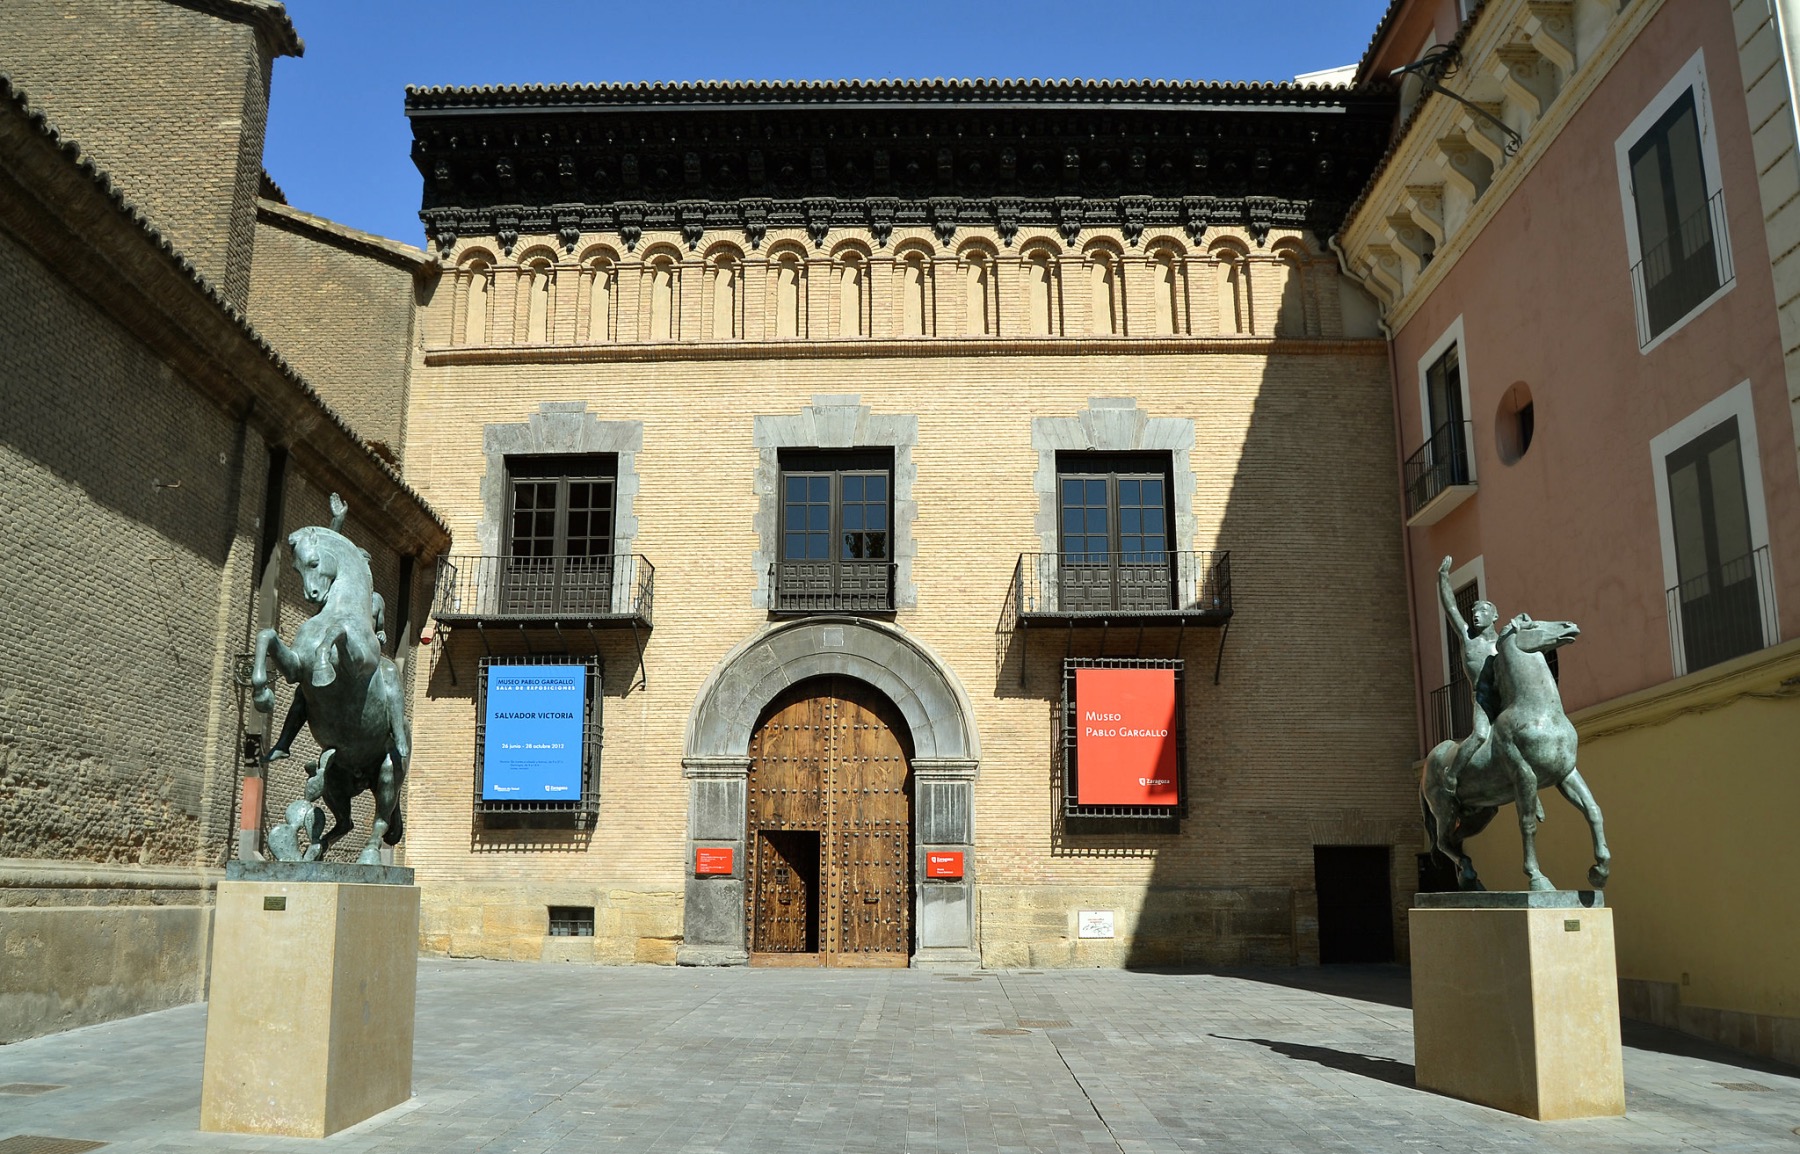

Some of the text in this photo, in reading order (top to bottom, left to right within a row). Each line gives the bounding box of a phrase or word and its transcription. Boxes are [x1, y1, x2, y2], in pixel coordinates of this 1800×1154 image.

[1085, 711, 1122, 721] MUSEO
[1085, 727, 1169, 738] PABLO GARGALLO
